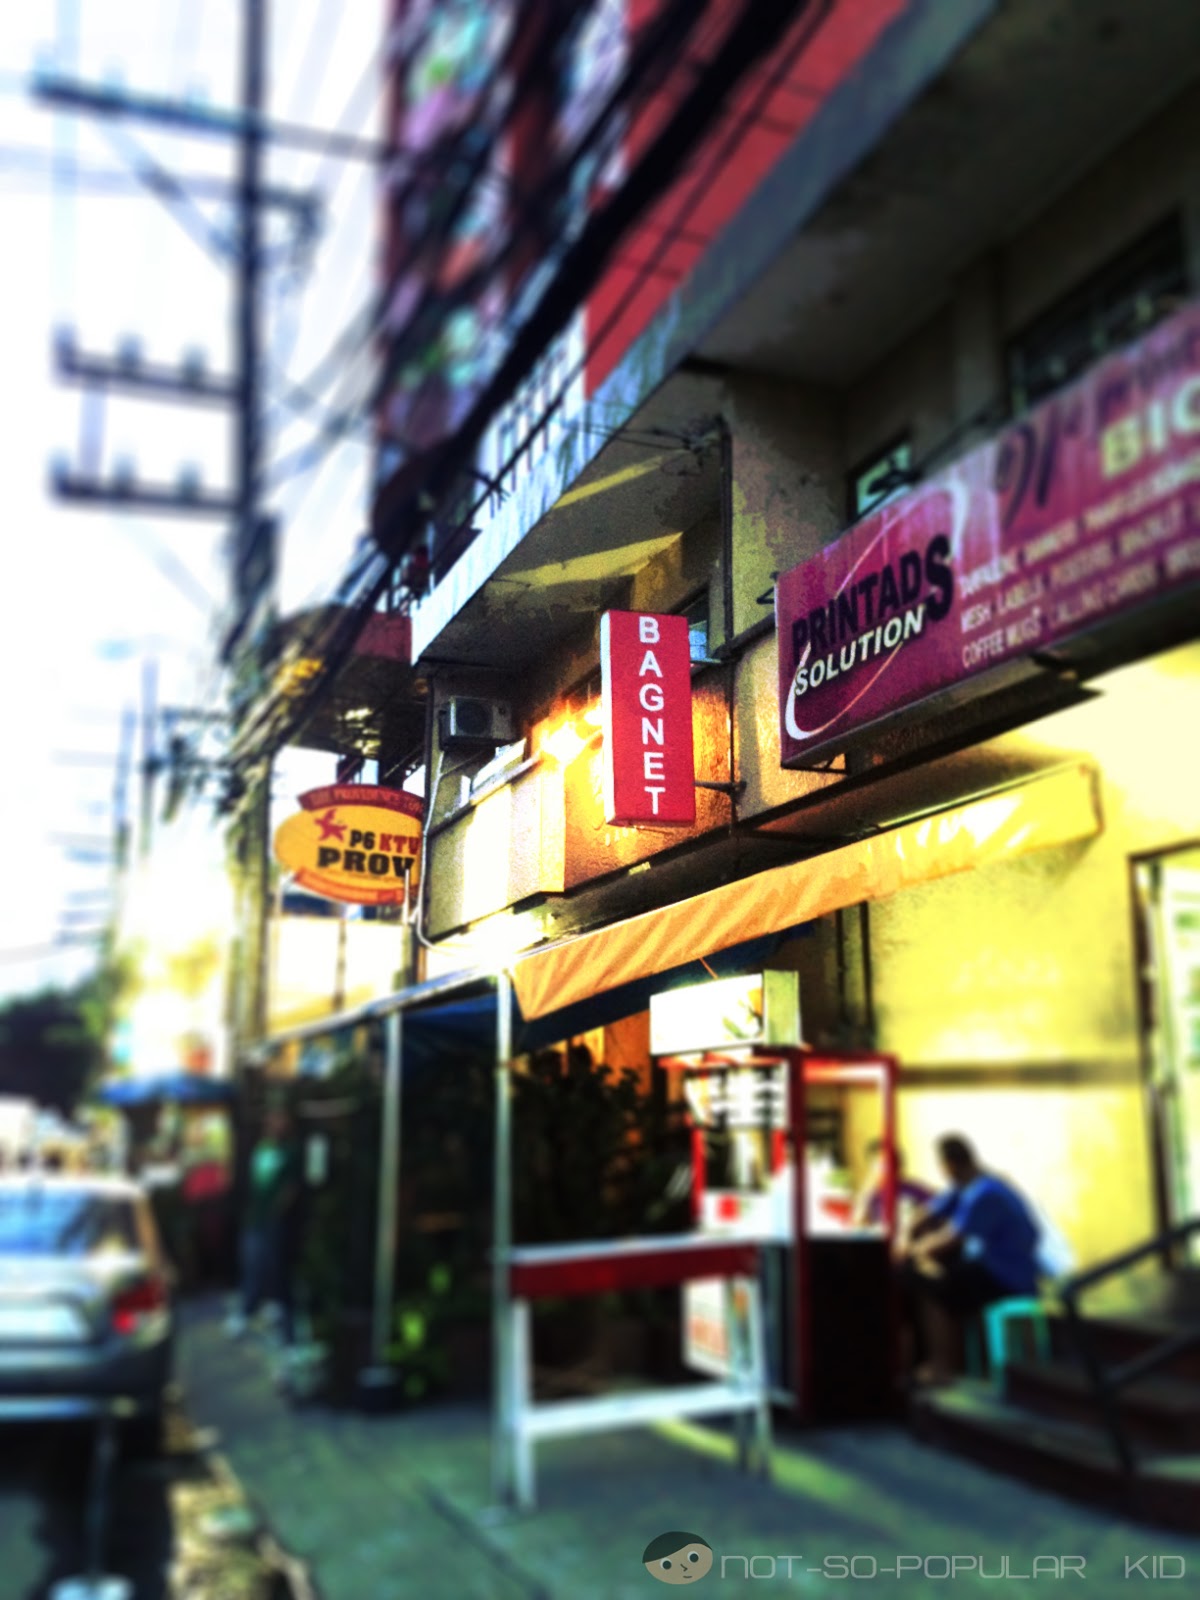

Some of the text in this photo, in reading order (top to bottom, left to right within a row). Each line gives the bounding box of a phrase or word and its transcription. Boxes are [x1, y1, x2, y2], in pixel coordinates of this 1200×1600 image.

[791, 534, 954, 673] PRINTADS
[794, 602, 925, 695] SOLUTION
[962, 628, 1004, 669] COFFEE
[638, 615, 666, 815] BAGNET
[317, 847, 416, 878] PROV
[350, 830, 376, 851] P6
